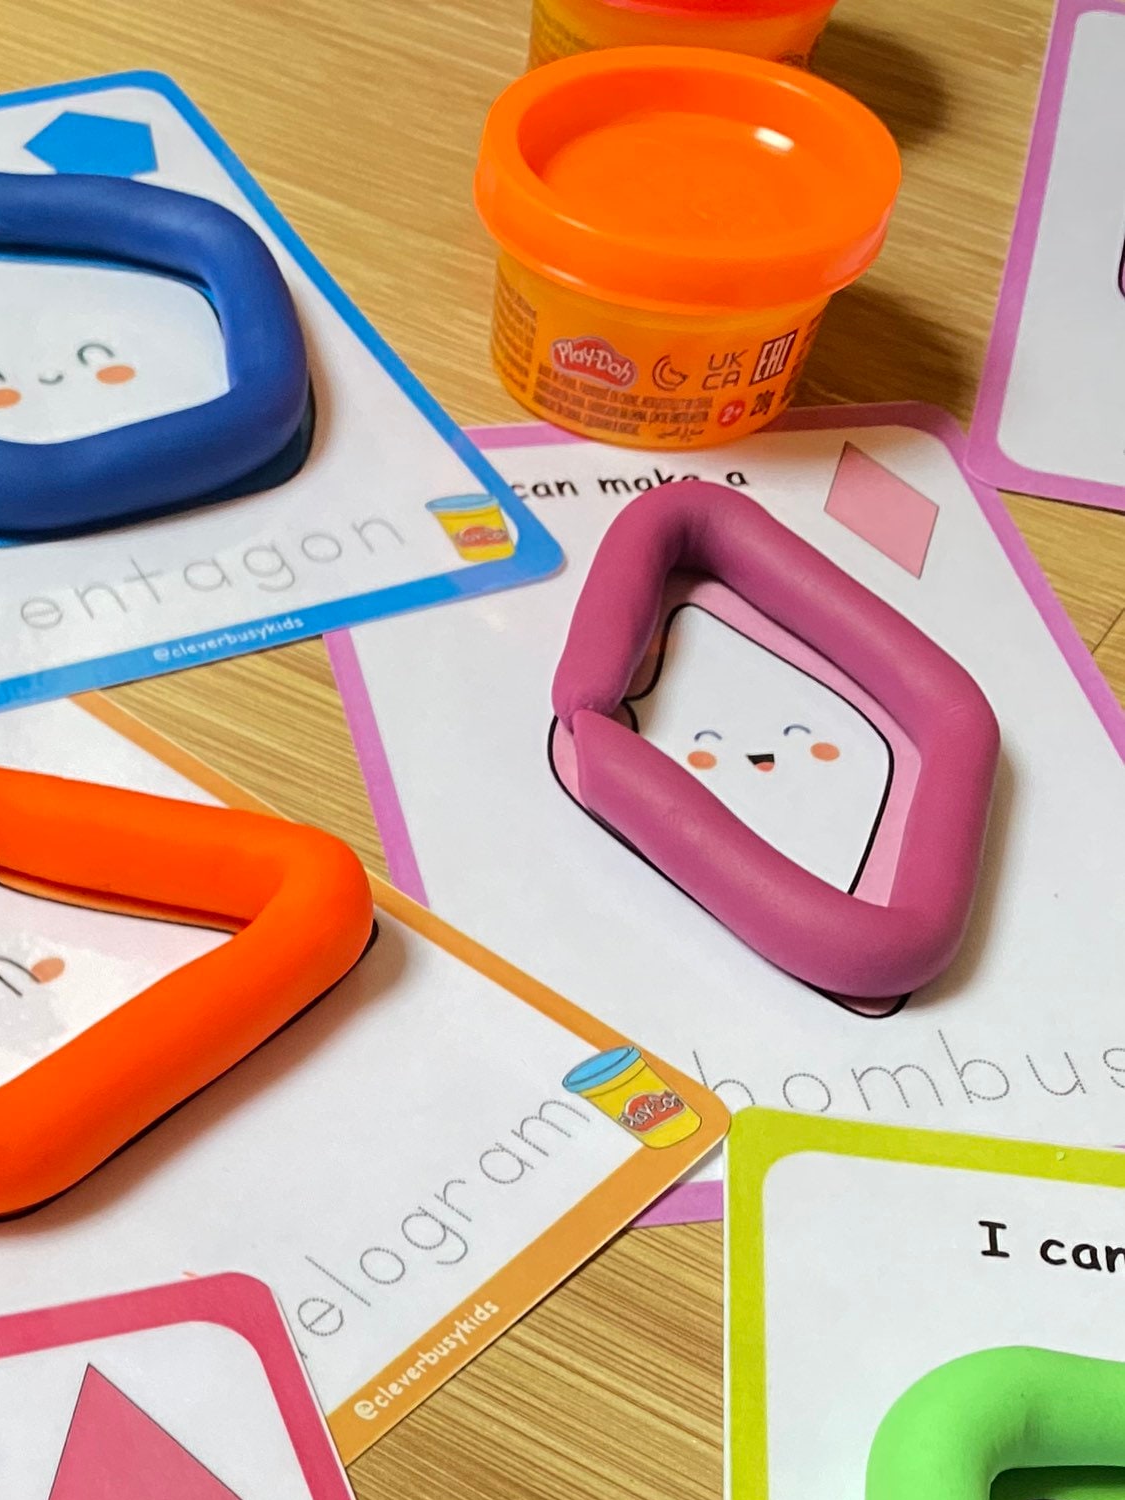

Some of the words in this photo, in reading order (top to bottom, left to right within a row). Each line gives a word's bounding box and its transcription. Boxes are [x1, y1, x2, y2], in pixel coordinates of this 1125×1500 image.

[555, 341, 632, 383] Play-Doh
[702, 370, 741, 390] CA
[708, 349, 748, 371] UK
[725, 471, 749, 487] a
[153, 616, 305, 662] @cleverbusykids
[297, 1099, 591, 1337] elogram
[978, 1220, 1011, 1259] I
[353, 1299, 500, 1421] @cleverbusykids
